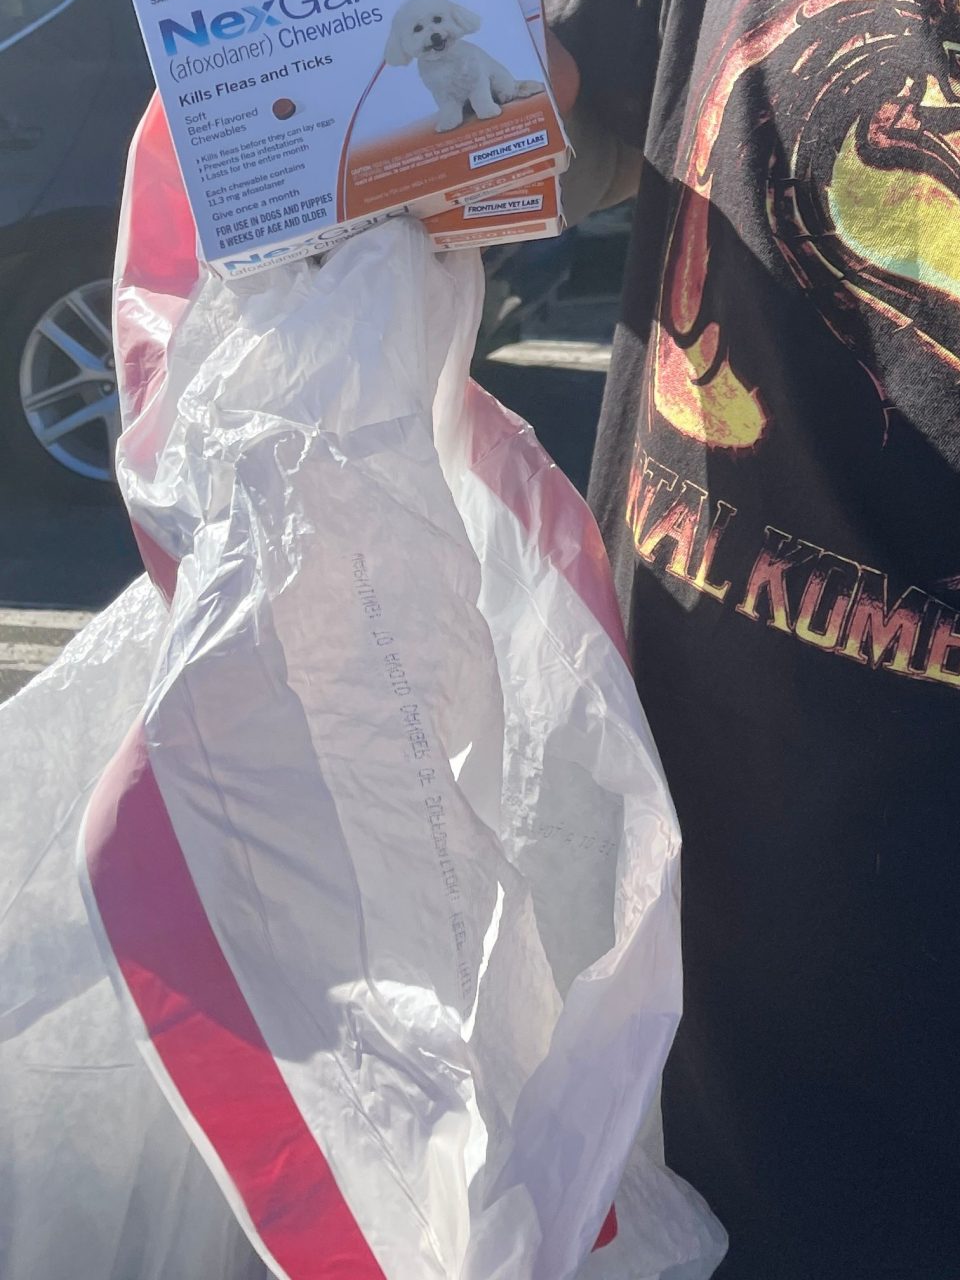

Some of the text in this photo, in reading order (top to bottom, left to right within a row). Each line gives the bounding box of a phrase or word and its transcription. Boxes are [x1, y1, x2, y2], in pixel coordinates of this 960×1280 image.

[169, 5, 383, 84] (afoxolaner) Chewables
[178, 54, 333, 108] Kills Fleas and Ticks
[185, 111, 207, 126] Soft
[187, 107, 259, 136] Beef-Flavored
[190, 123, 247, 147] Chewables
[200, 118, 336, 163] Kills fleas before they can lay eggs
[203, 136, 304, 172] Prevents flea infestations
[473, 134, 545, 163] FRONTLINE VET LABS
[205, 143, 310, 182] Lasts for the entire month
[205, 162, 306, 199] Each chewable contains
[207, 178, 285, 208] 11.3 mg afoxolaner
[212, 188, 300, 222] Give once a month
[468, 197, 540, 214] FRONTLINE VET LABS
[215, 192, 333, 238] FOR USE IN DOGS AND PUPPIES
[219, 207, 328, 250] 8 WEEKS OF AGE AND OLDER
